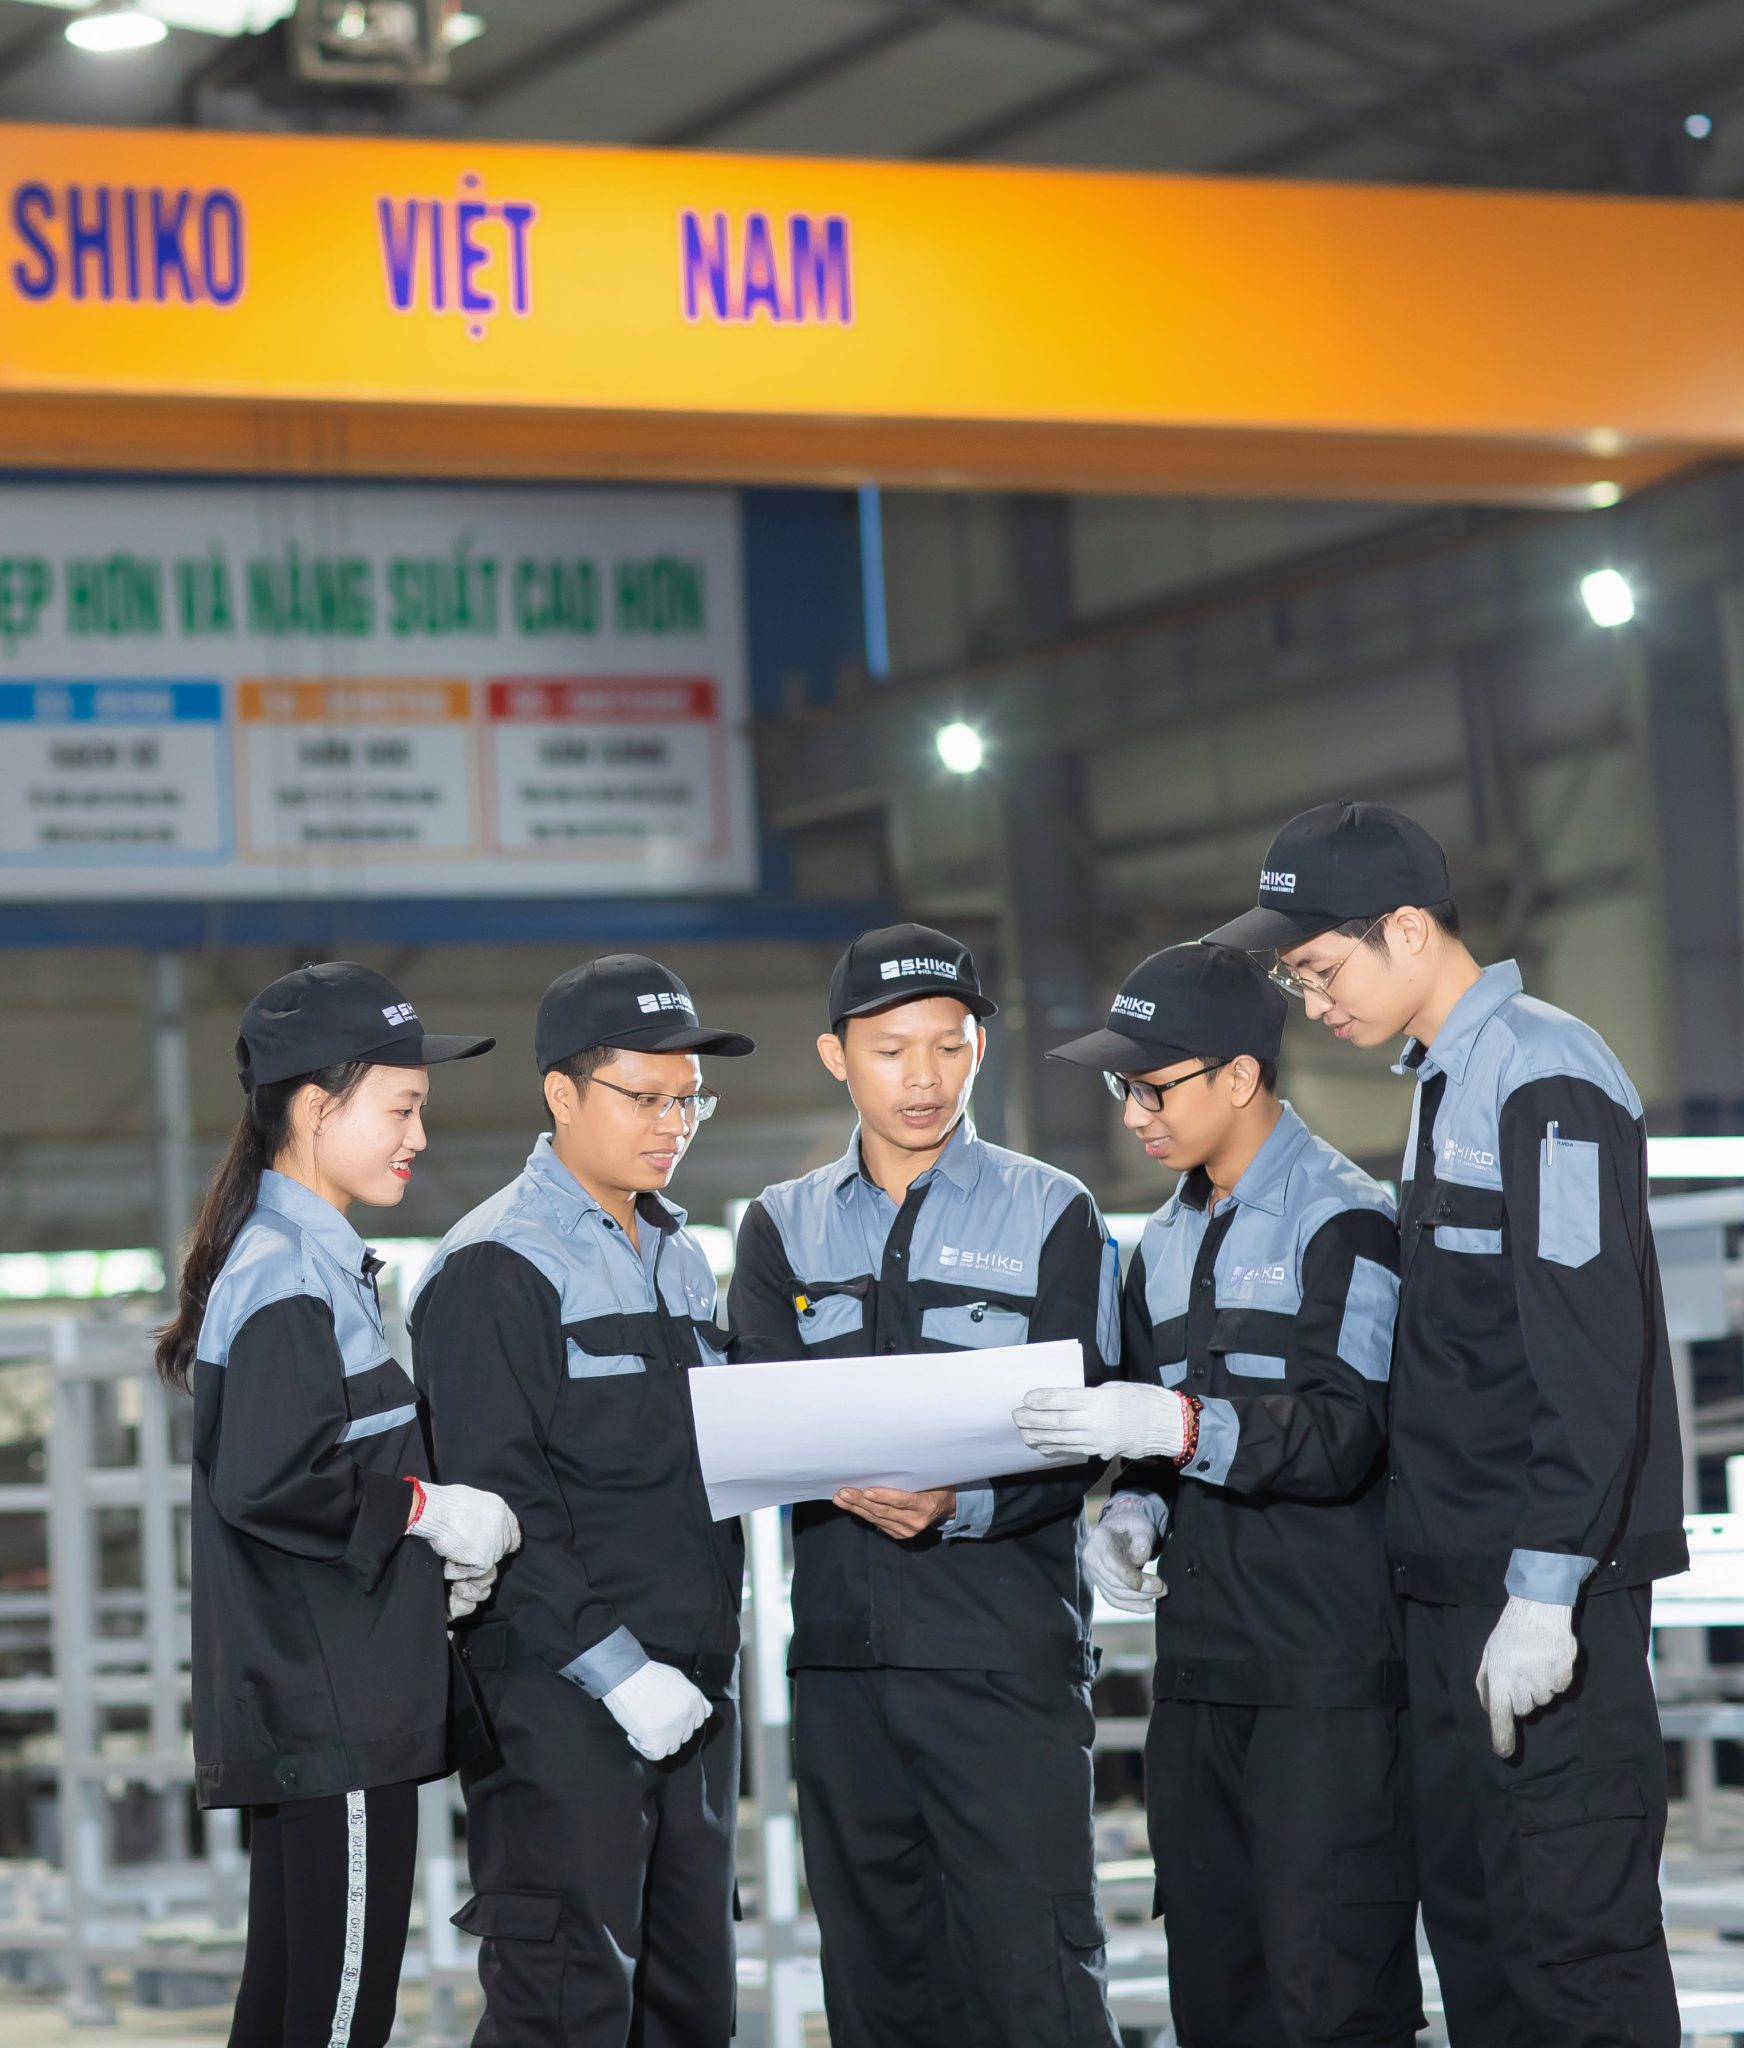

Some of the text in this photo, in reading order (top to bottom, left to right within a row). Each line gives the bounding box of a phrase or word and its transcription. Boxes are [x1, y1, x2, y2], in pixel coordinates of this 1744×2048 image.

[11, 182, 245, 306] SHIKO
[681, 210, 854, 324] NAM
[900, 957, 957, 977] SHIKO
[960, 1251, 1024, 1273] SHIKO
